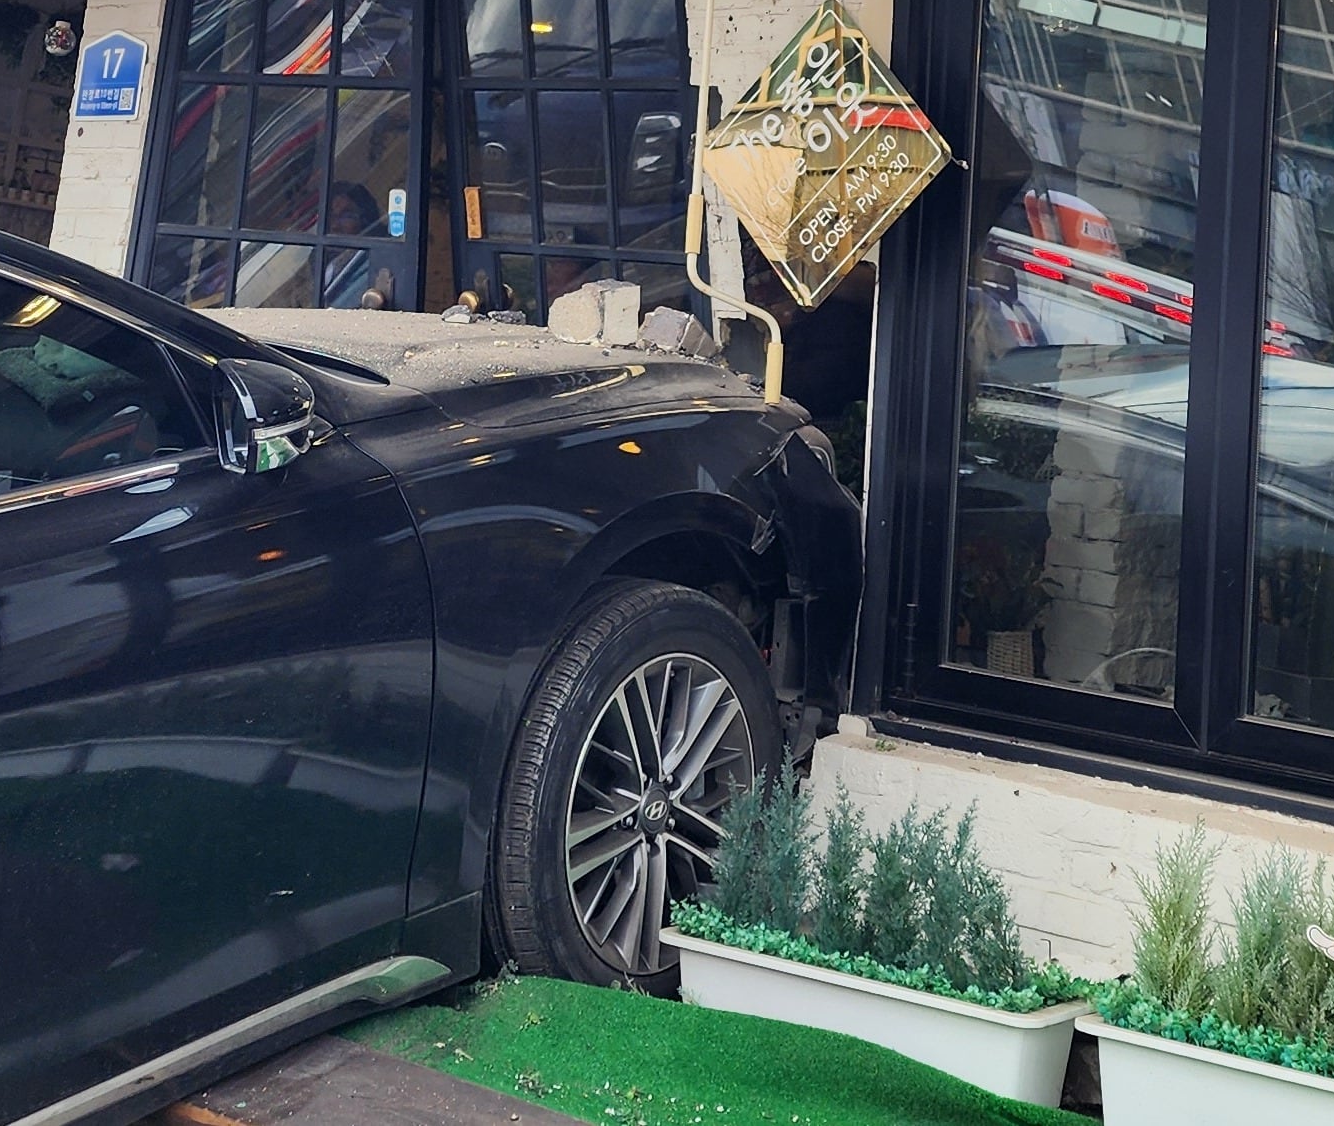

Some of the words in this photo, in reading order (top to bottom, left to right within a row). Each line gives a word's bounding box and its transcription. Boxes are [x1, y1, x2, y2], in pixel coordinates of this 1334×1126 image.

[102, 48, 125, 79] 17
[776, 41, 844, 116] 좋은
[767, 157, 807, 206] cae
[804, 82, 878, 154] 이웃
[846, 161, 870, 199] AM
[866, 135, 897, 171] 9:30
[857, 185, 883, 215] PM
[879, 152, 911, 189] 9:30
